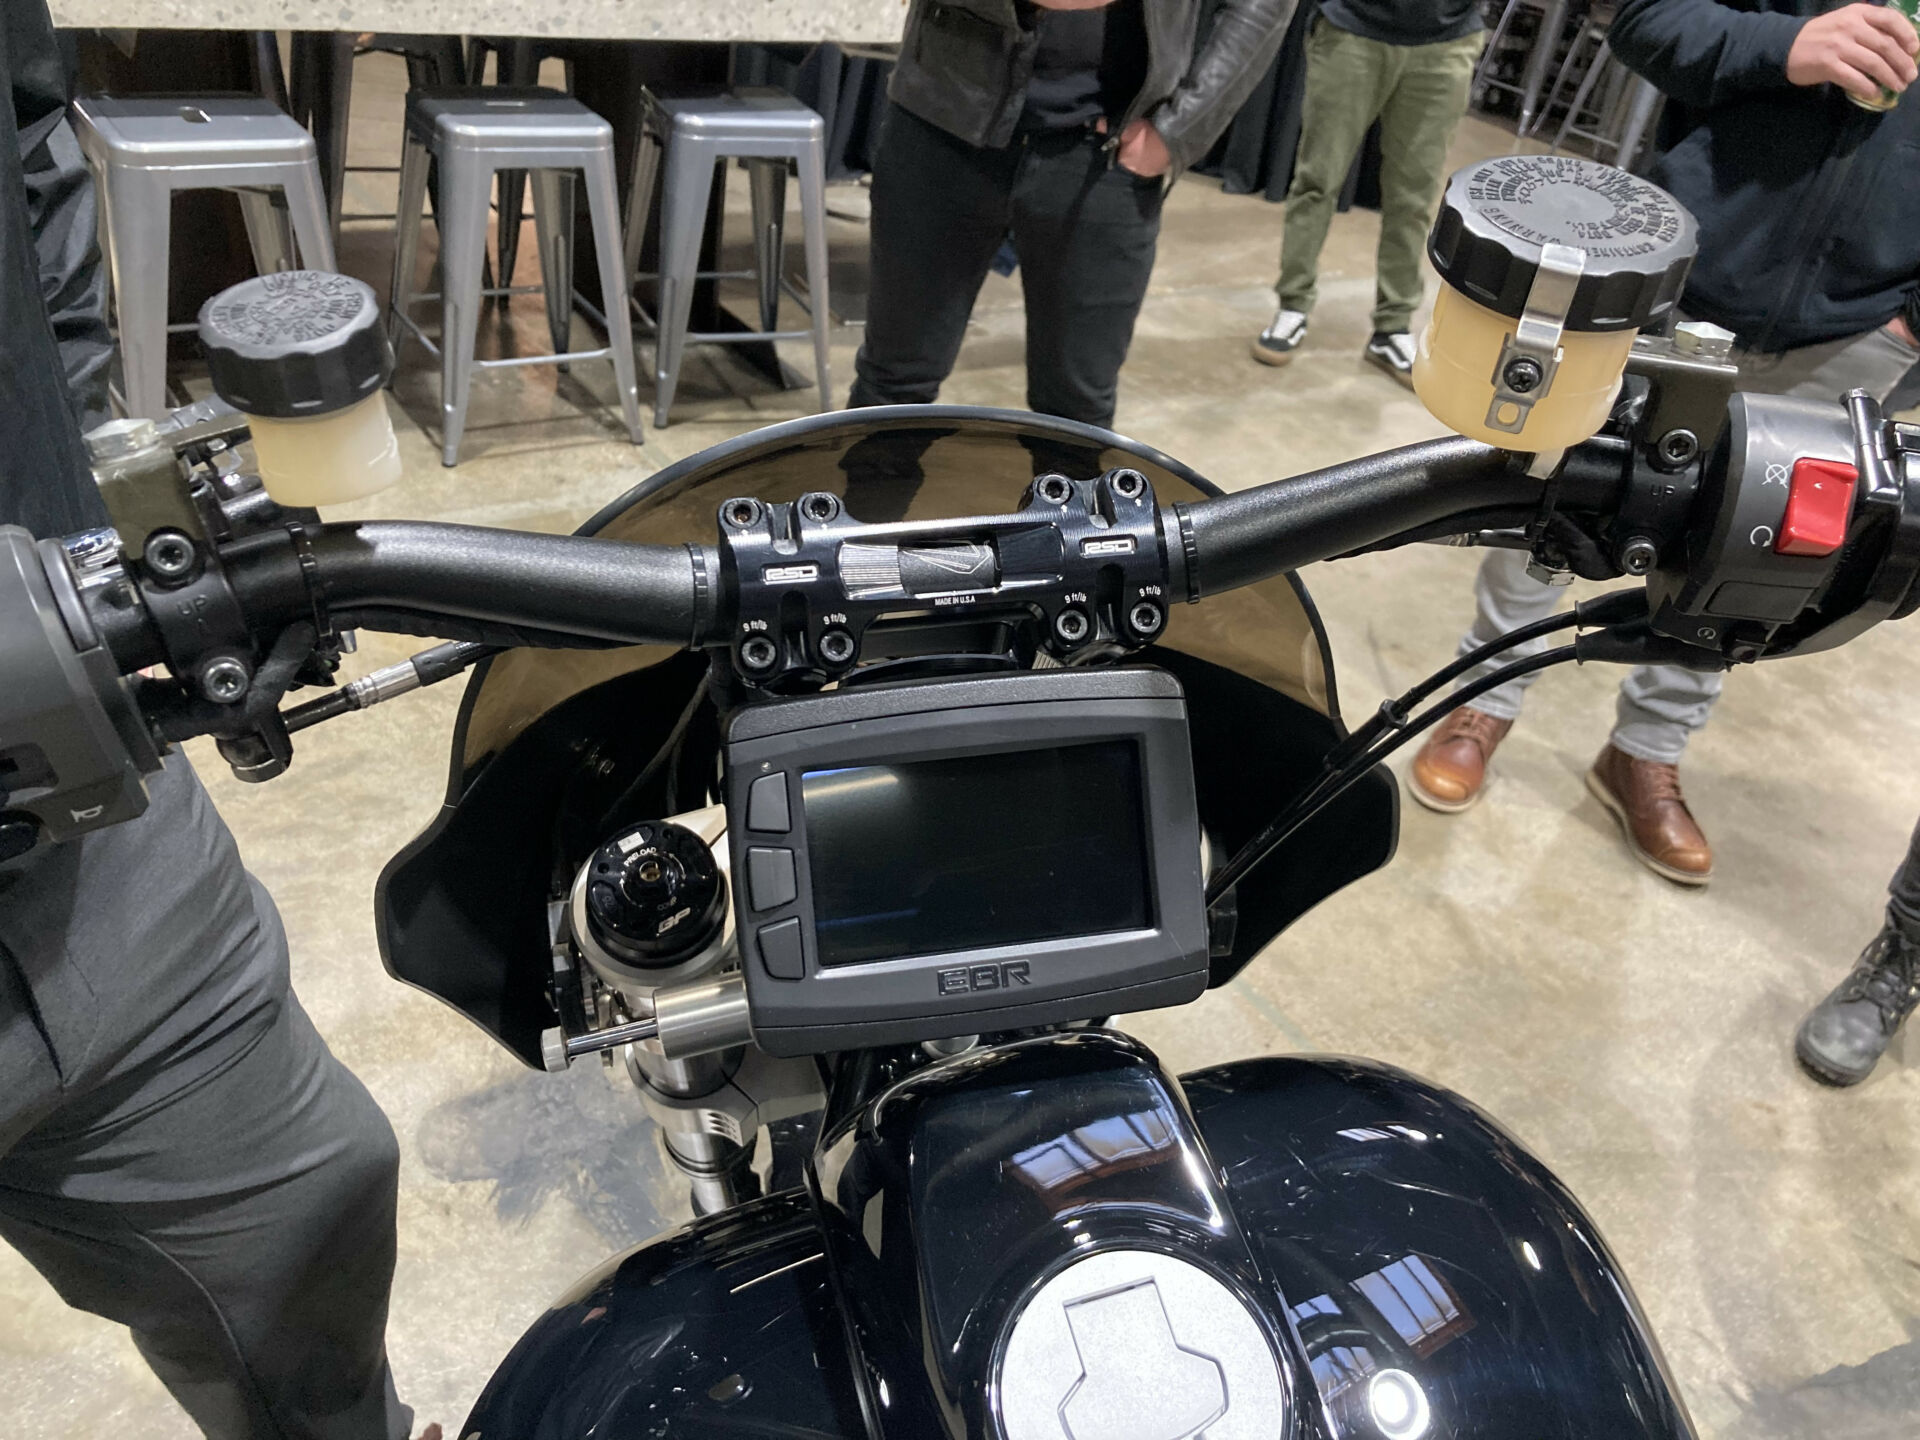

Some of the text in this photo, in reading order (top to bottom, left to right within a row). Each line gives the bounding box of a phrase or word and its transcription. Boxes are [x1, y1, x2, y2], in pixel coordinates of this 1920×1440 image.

[1483, 208, 1562, 246] WARNING
[1650, 484, 1676, 497] UP
[1146, 584, 1161, 596] ft/lb
[934, 597, 952, 606] MADE
[1071, 591, 1087, 602] ft/lb
[178, 594, 207, 617] UP
[831, 612, 848, 624] ft/lb
[751, 619, 768, 631] ft/lb
[623, 846, 657, 867] PRELOAD
[936, 958, 1032, 996] EBR
